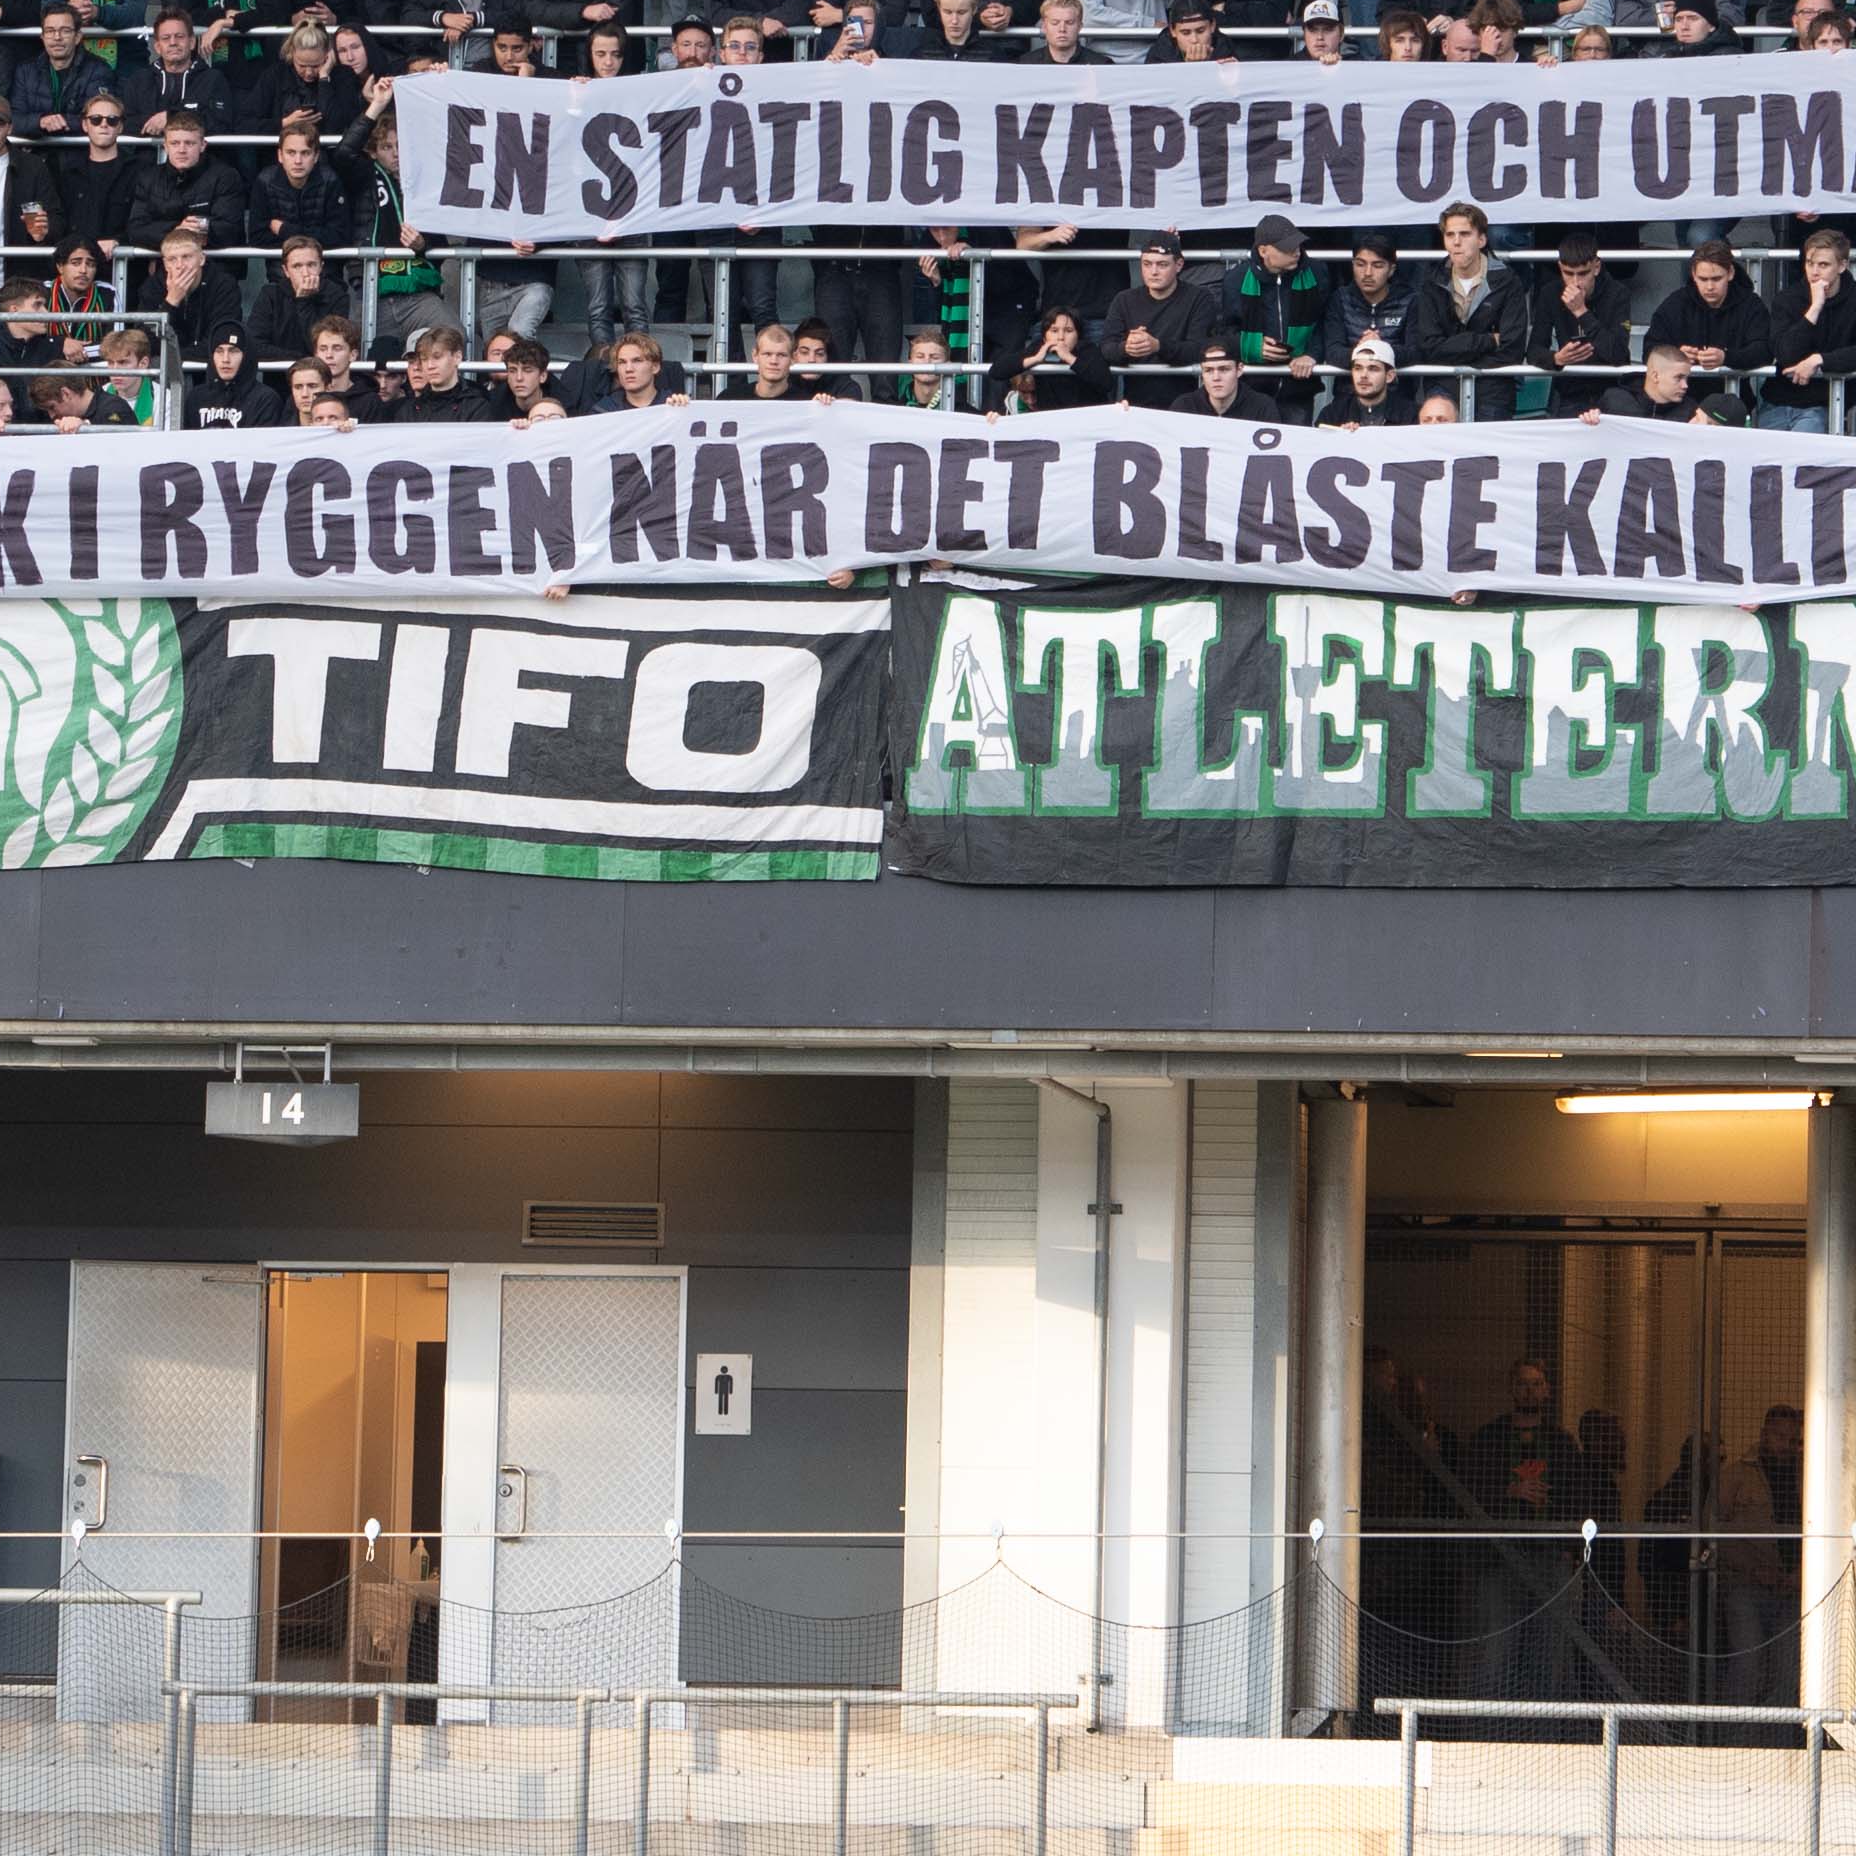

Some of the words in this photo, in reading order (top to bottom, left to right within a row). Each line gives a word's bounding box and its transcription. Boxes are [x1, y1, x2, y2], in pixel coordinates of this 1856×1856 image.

[440, 104, 550, 210] EN
[582, 73, 962, 220] STÅTLIG
[996, 101, 1364, 208] KAPTEN
[1397, 100, 1602, 202] OCH
[70, 466, 98, 579] I
[140, 457, 575, 579] RYGGEN
[610, 421, 828, 563] NÄR
[865, 439, 1059, 553] DET
[1093, 429, 1498, 572] BLÅSTE
[227, 617, 822, 793] TIFO
[262, 1092, 305, 1125] 14
